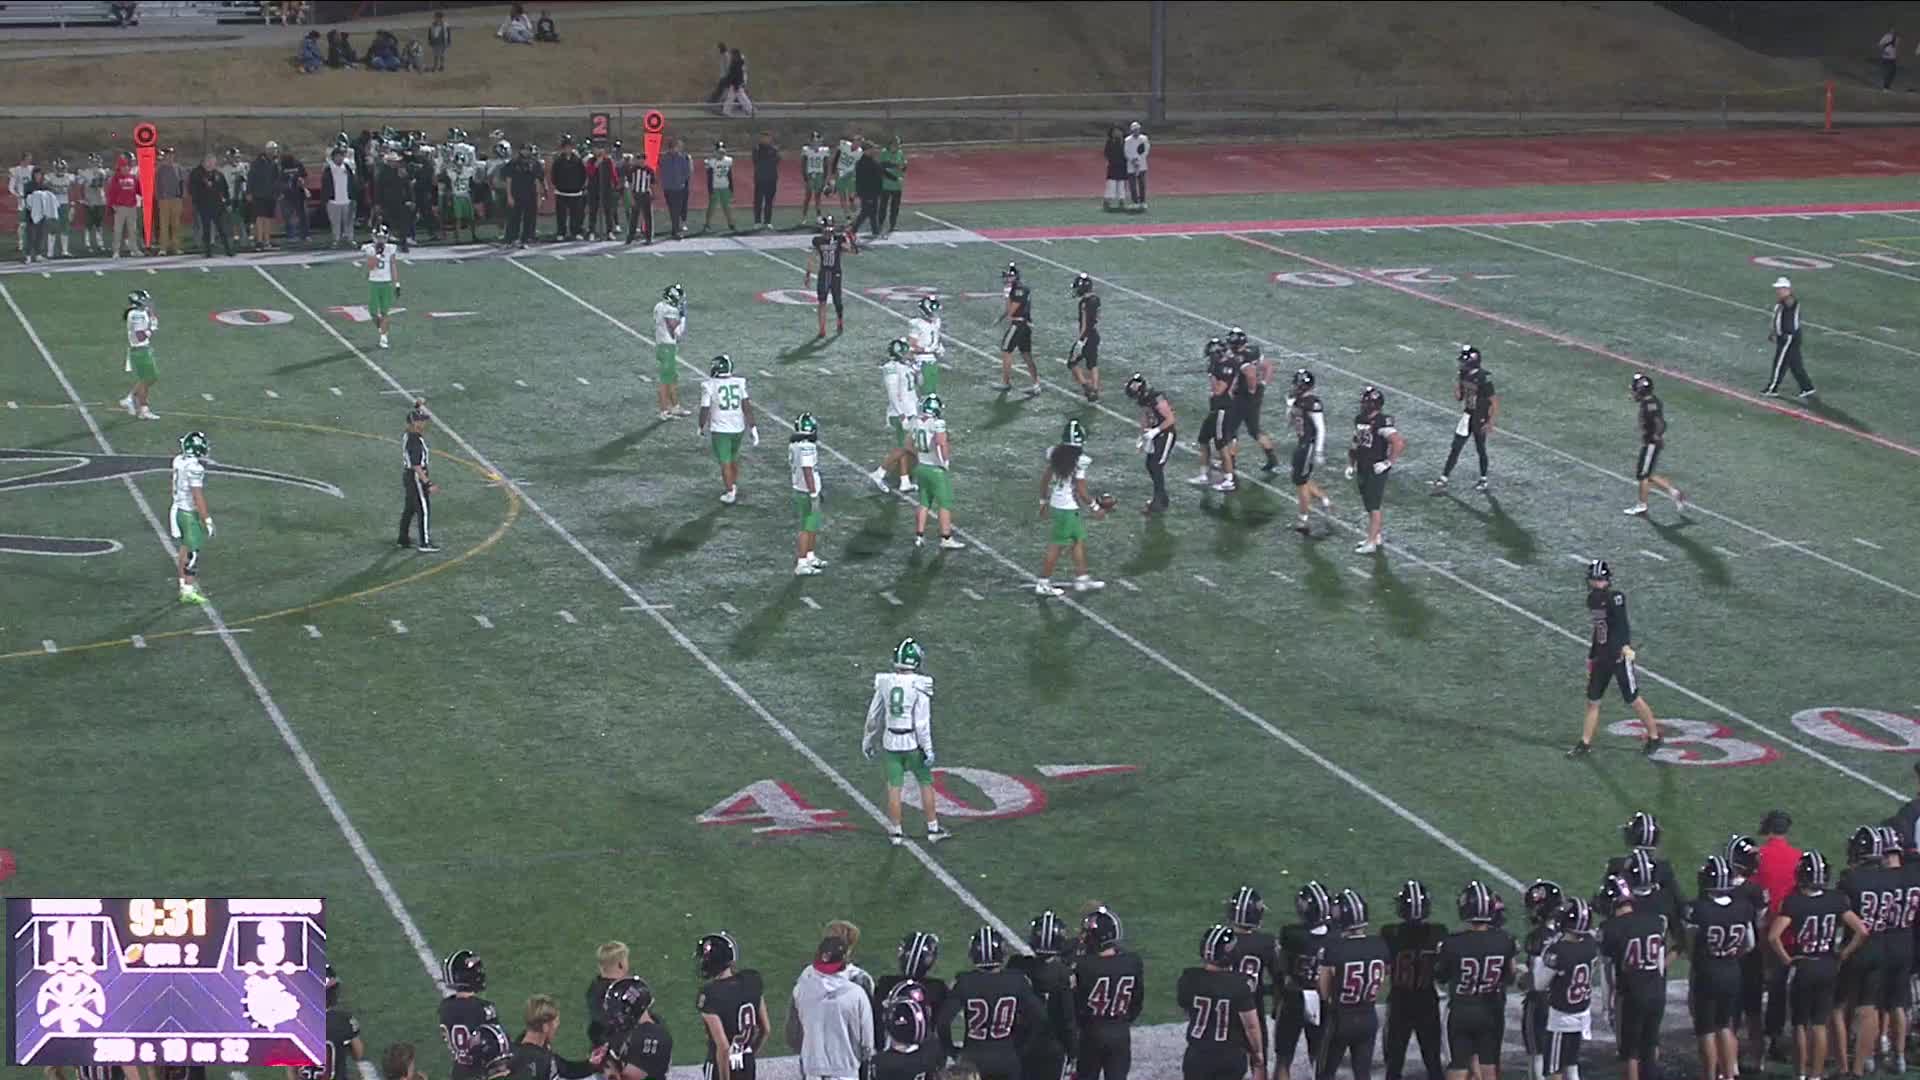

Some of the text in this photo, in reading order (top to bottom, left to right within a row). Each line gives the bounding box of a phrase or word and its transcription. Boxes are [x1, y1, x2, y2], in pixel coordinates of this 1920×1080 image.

[592, 116, 609, 136] 2
[717, 384, 741, 411] 35
[890, 686, 904, 718] 8
[1797, 914, 1837, 953] 41
[1088, 976, 1135, 1017] 46
[1340, 958, 1386, 1005] 58
[1457, 956, 1506, 997] 35
[967, 996, 1017, 1041] 20
[1191, 996, 1231, 1042] 71
